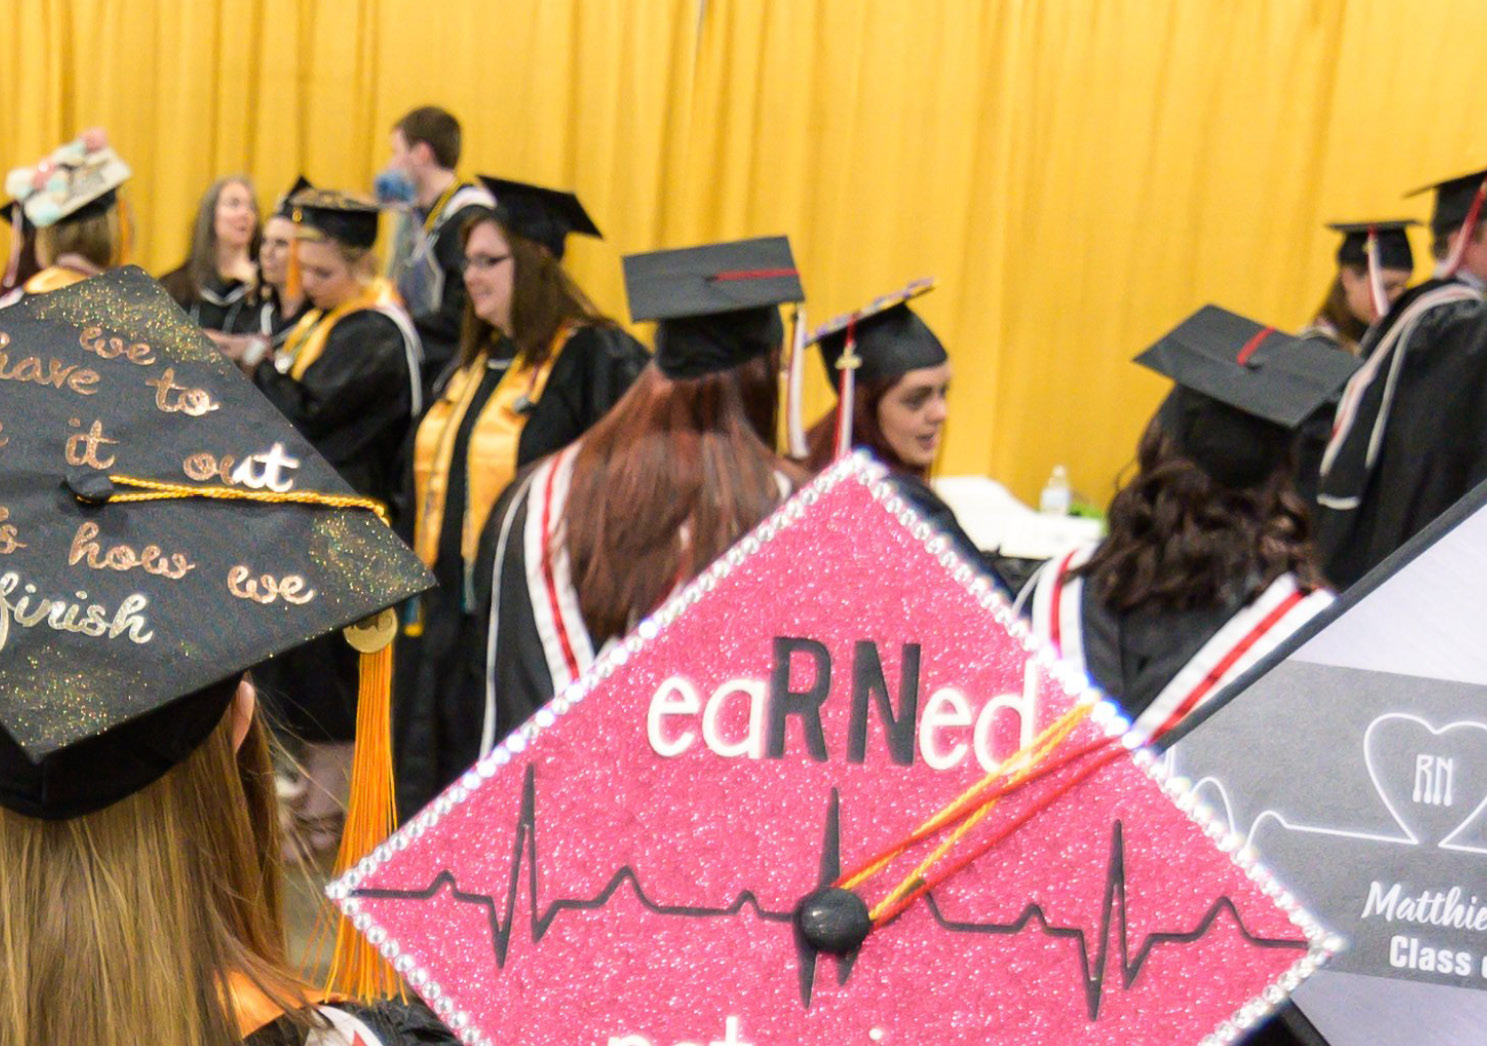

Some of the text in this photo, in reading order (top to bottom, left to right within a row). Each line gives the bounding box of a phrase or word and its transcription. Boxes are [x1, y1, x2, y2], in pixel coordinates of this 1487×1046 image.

[80, 326, 156, 366] we
[146, 368, 219, 416] to
[65, 417, 116, 470] it
[183, 442, 300, 493] out
[69, 522, 195, 579] how
[228, 565, 315, 604] we
[647, 636, 1038, 775] eaRNed
[1412, 754, 1454, 807] RN
[1389, 935, 1472, 977] Class
